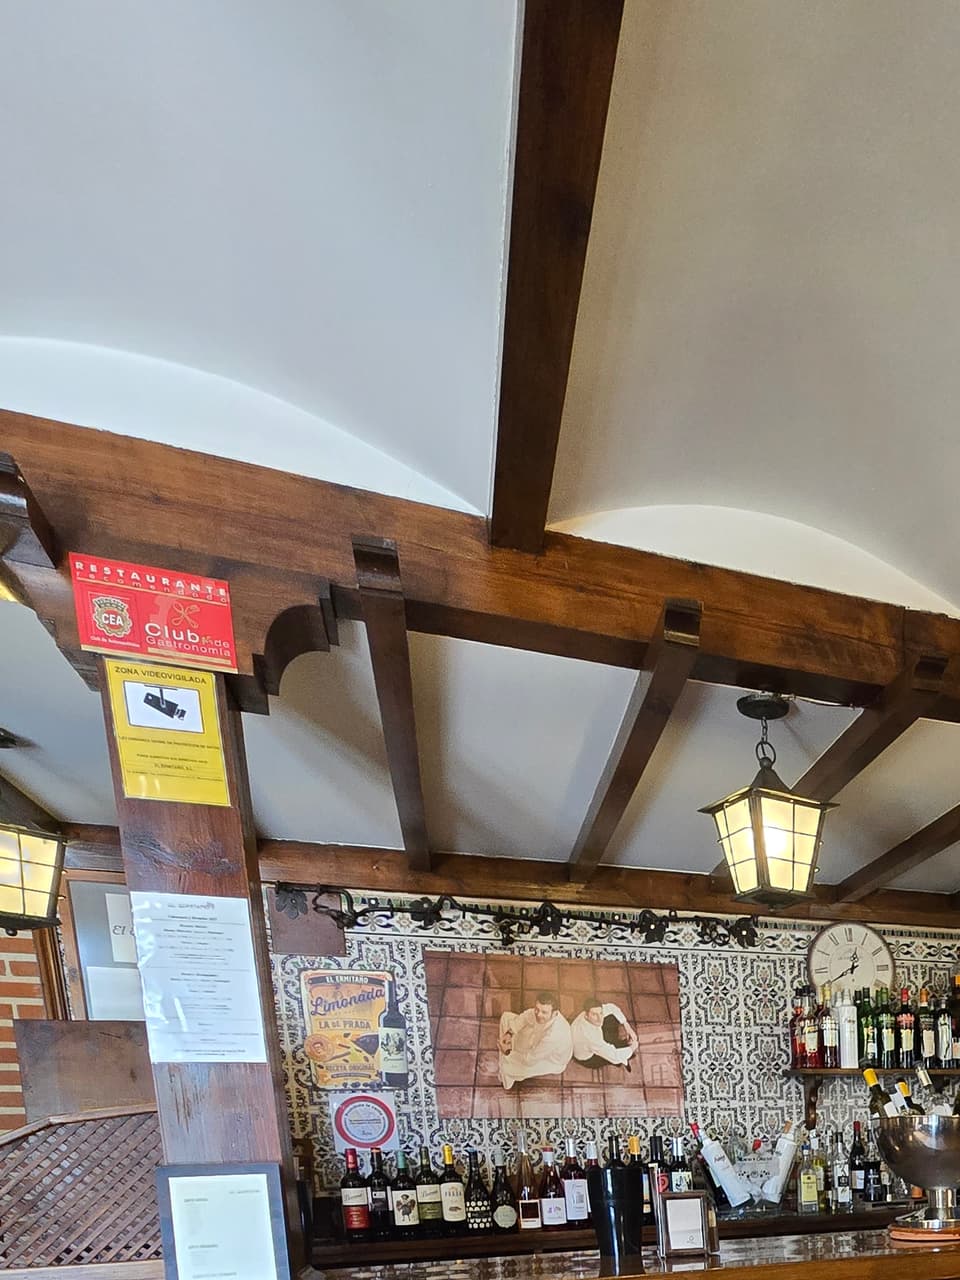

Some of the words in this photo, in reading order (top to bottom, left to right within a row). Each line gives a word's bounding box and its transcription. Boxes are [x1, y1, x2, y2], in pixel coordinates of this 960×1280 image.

[75, 561, 226, 596] RESTAURANTE
[101, 613, 124, 626] CEA
[145, 622, 200, 643] Club
[114, 666, 140, 676] ZONA
[141, 670, 207, 685] VIDEOVIGILADA
[311, 987, 385, 1016] Limonada
